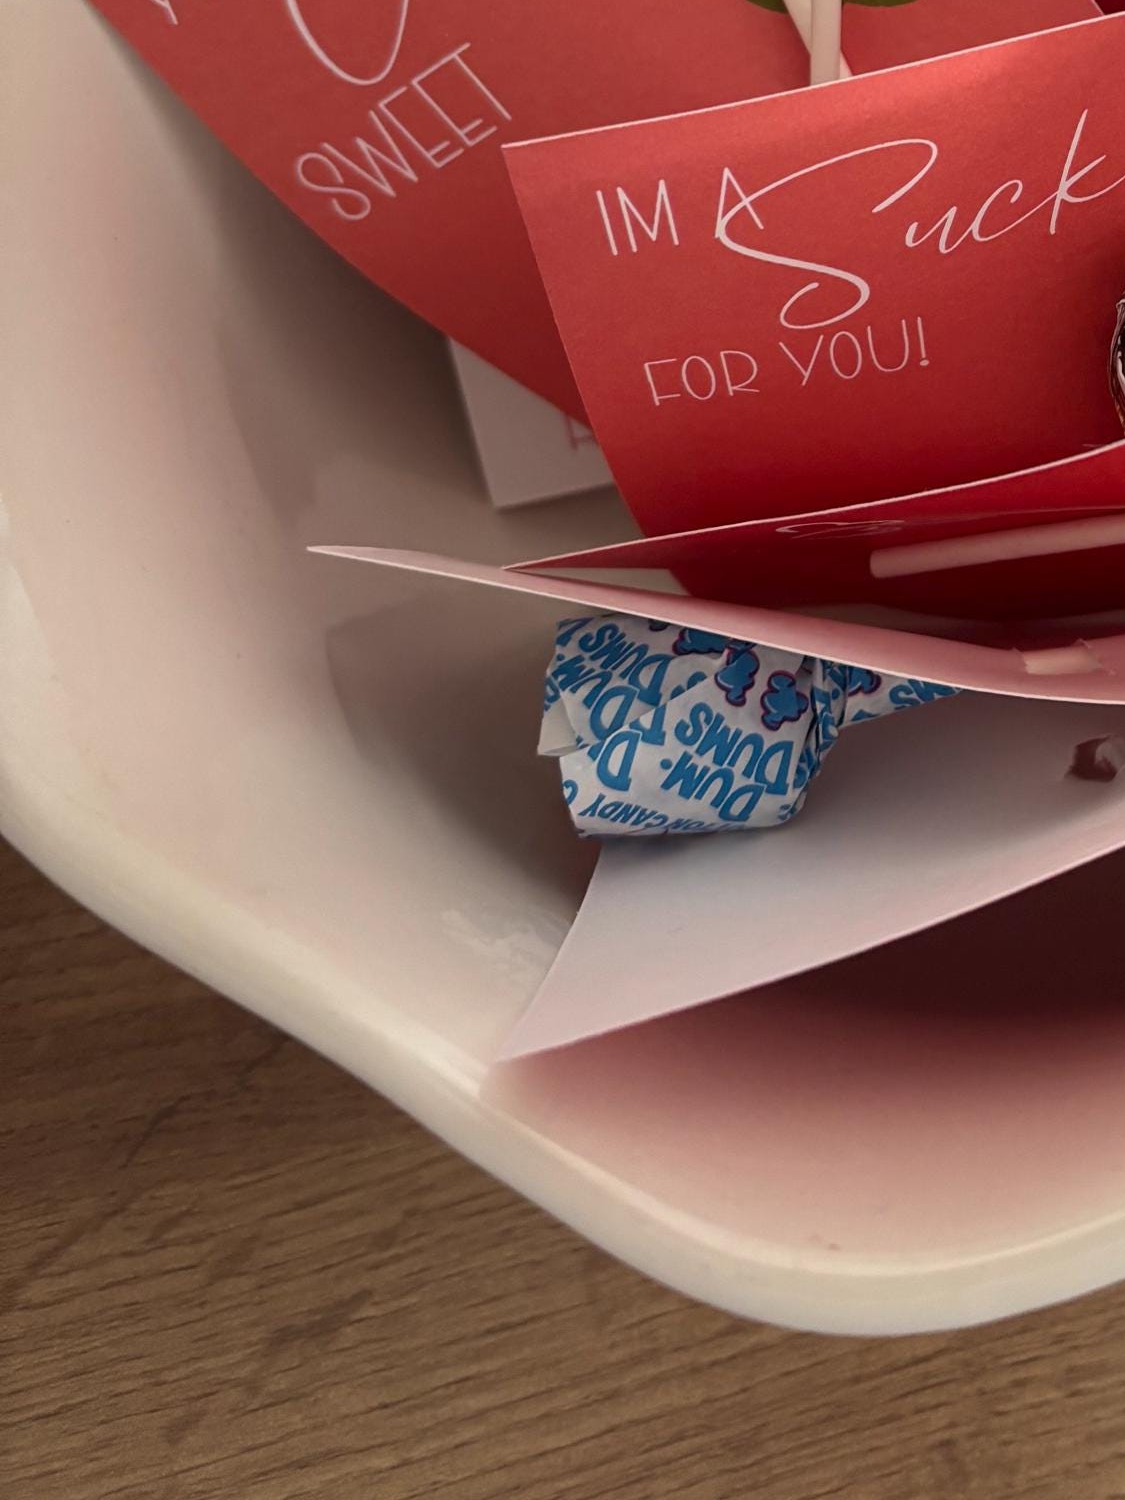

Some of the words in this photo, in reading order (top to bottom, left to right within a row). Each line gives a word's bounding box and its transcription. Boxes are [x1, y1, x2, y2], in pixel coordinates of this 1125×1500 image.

[295, 41, 513, 222] SWEET
[595, 177, 681, 256] IM
[714, 165, 766, 240] A
[642, 348, 762, 408] FOR
[780, 315, 931, 387] YOU!
[578, 622, 675, 707] DUMS
[673, 701, 796, 797] DUMS
[577, 793, 671, 831] CANDY
